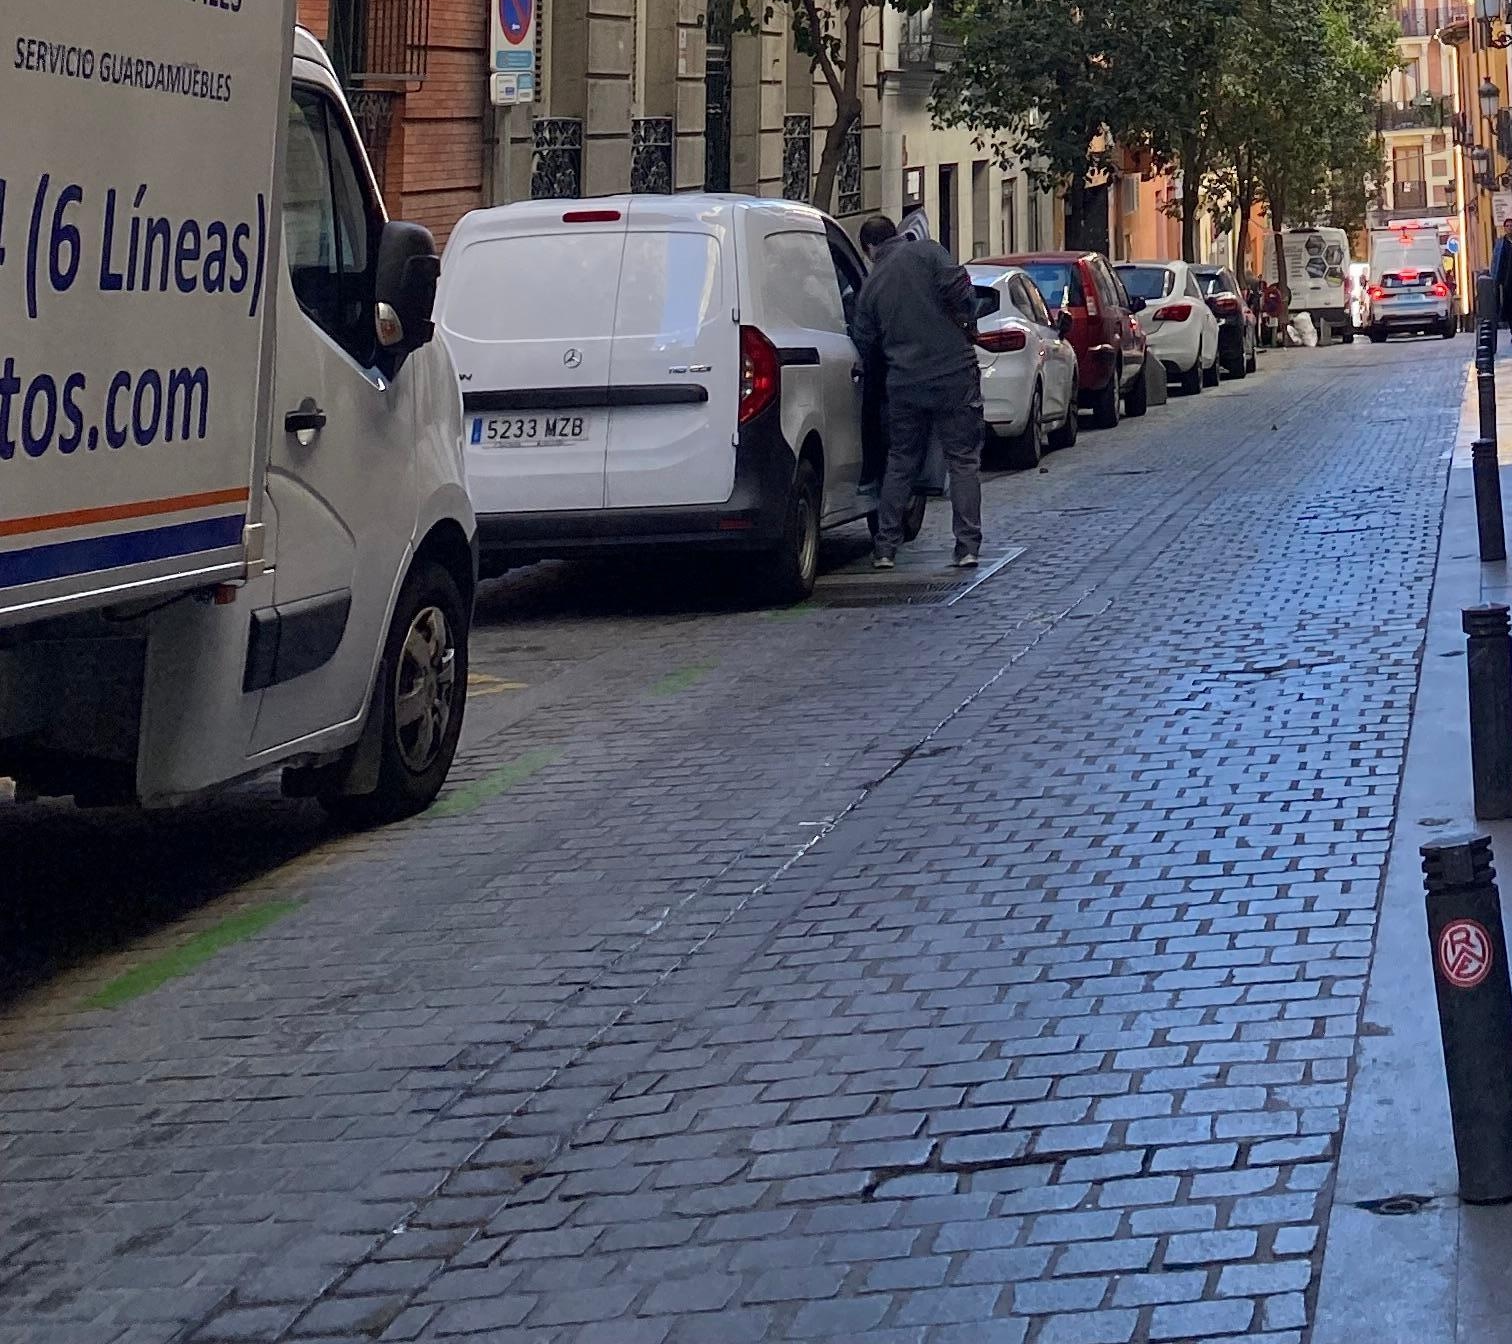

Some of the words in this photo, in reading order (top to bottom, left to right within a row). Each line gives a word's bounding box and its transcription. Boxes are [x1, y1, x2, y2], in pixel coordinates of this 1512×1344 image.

[15, 38, 95, 80] SERVICIO
[100, 52, 232, 102] GUARDAMUEBLES
[27, 173, 83, 319] (6
[100, 184, 266, 317] Líneas)
[487, 419, 538, 439] 5233
[544, 417, 583, 437] MZB
